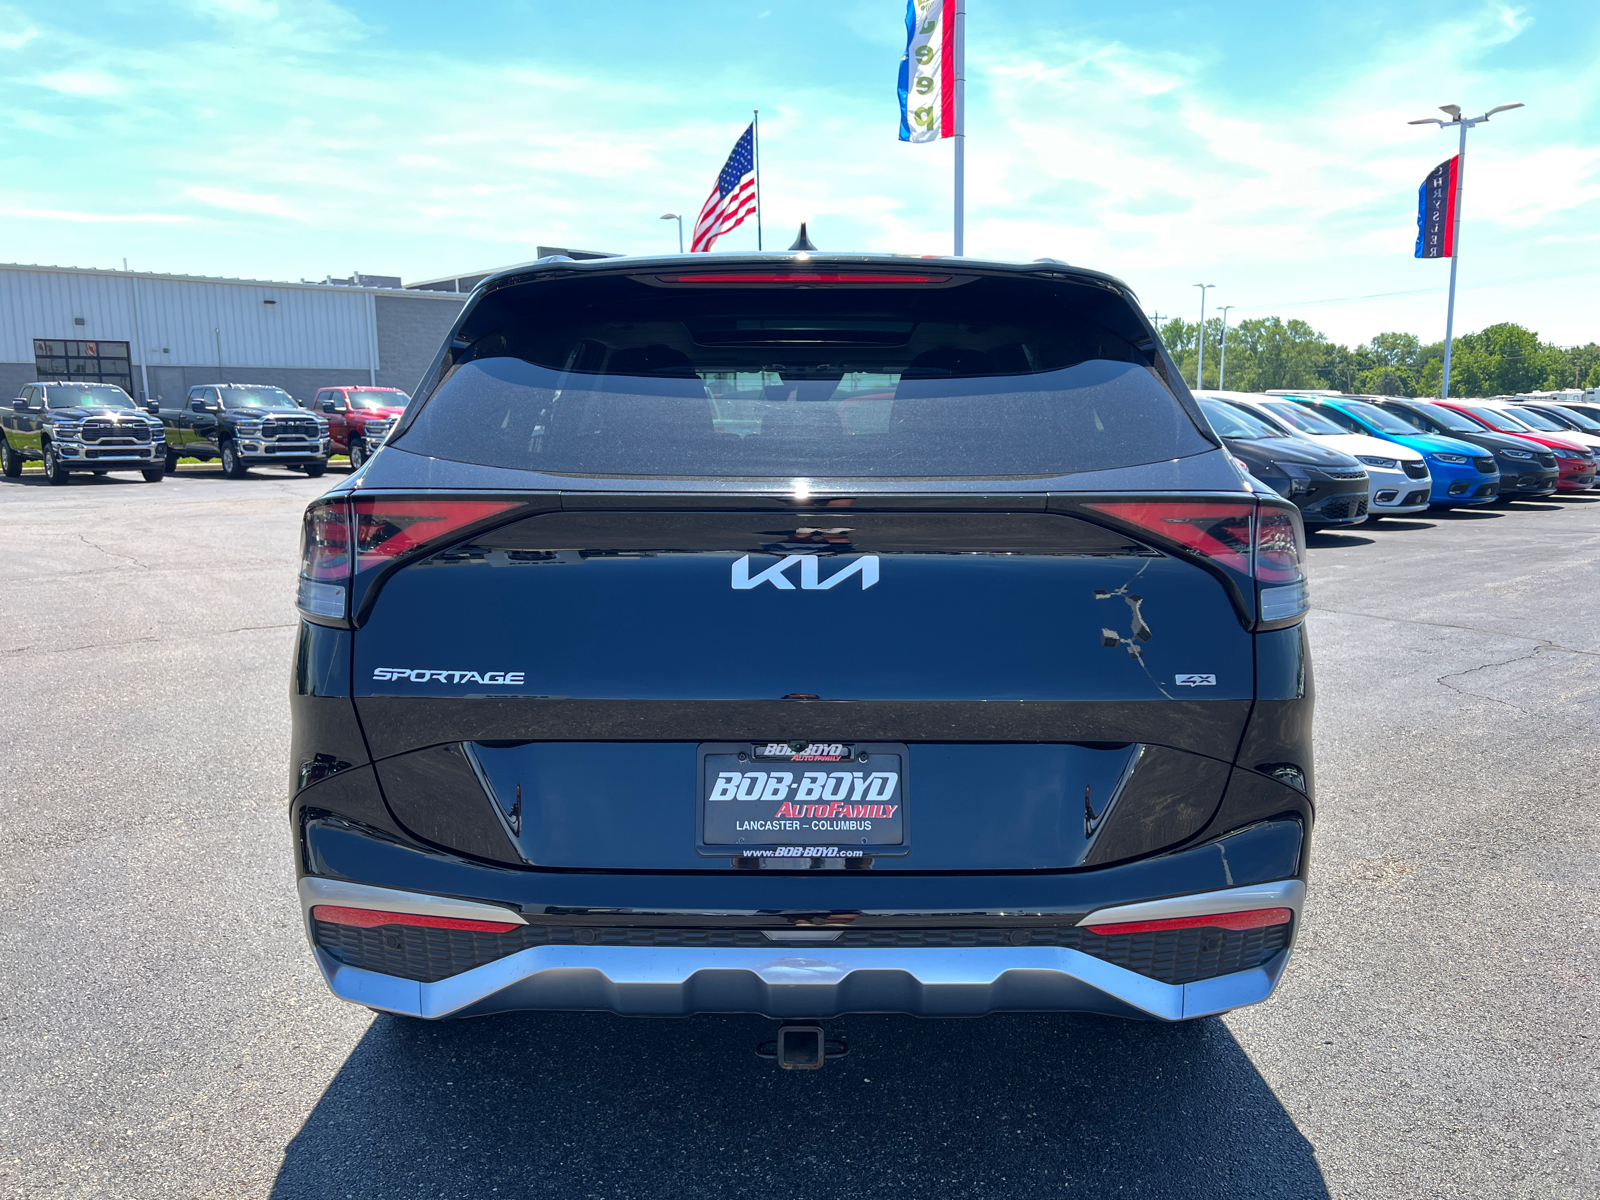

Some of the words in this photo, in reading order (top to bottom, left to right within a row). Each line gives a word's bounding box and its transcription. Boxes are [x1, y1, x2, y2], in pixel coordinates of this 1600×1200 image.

[731, 554, 880, 590] KIA
[372, 667, 525, 685] SPORTAGE
[763, 743, 843, 756] BOBOYD
[708, 771, 899, 801] BOB-BOYD
[736, 820, 800, 831] LANCASTER
[811, 820, 872, 831] COLUMBUS
[742, 846, 863, 857] www.BOB-BOYD.com
